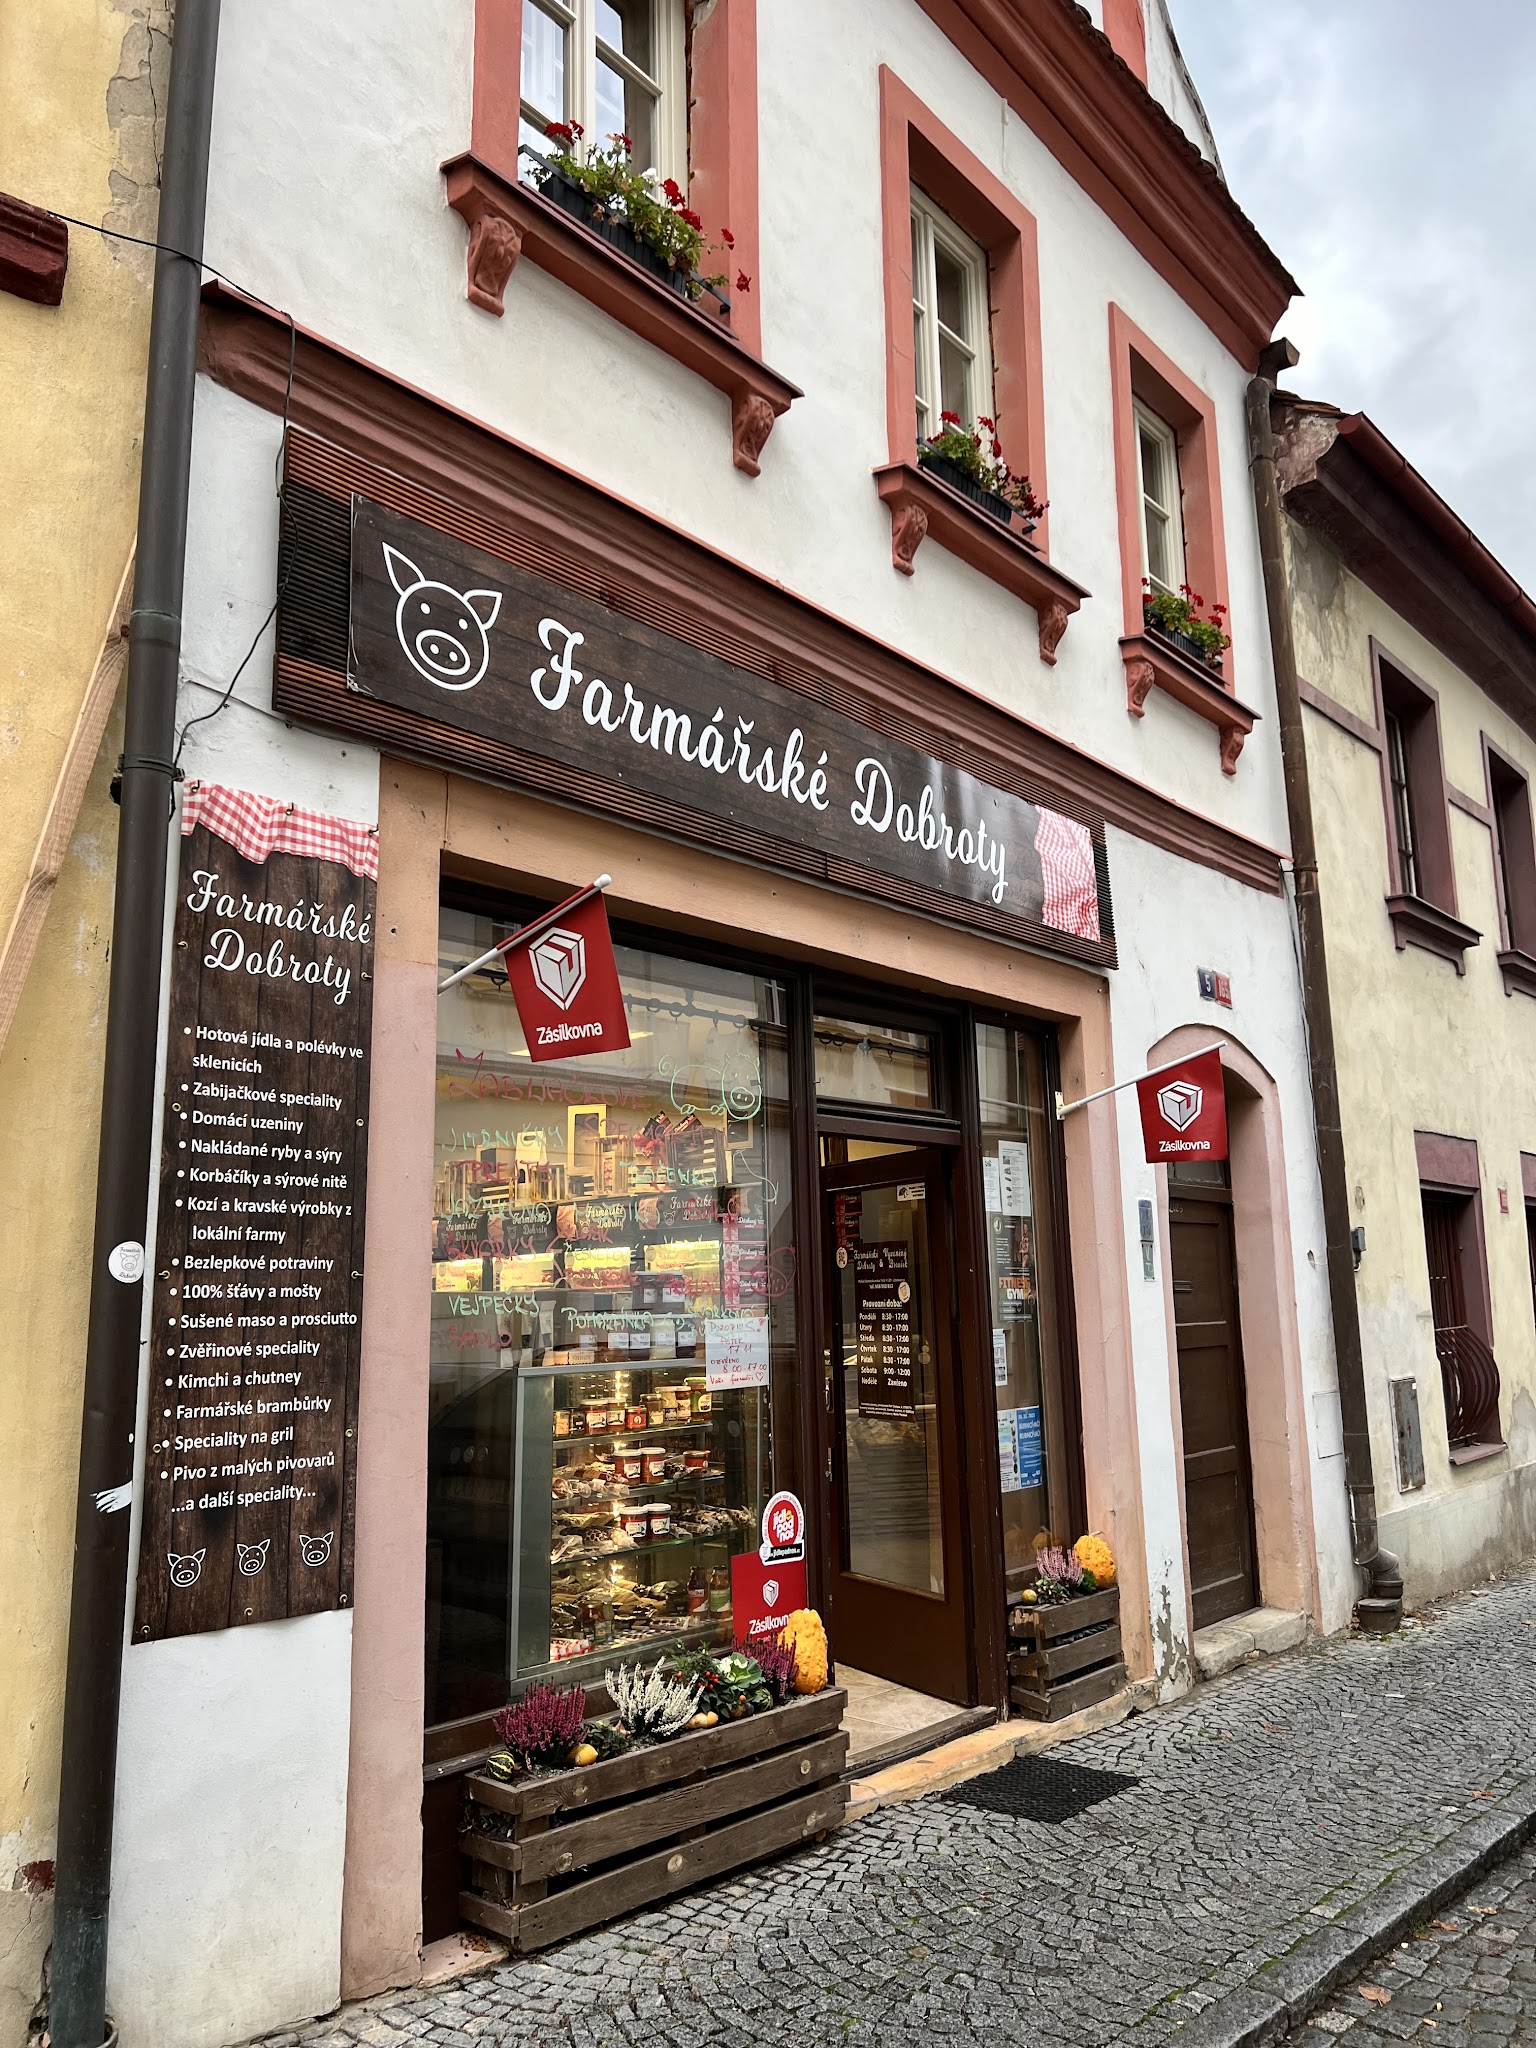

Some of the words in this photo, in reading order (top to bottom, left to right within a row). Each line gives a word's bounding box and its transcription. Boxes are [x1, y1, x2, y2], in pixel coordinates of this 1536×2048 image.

[530, 618, 829, 811] Farmářské
[850, 757, 1009, 904] Dobroty
[186, 869, 373, 944] Farmářské
[203, 928, 353, 1005] Dobroty
[1204, 974, 1212, 993] 5
[196, 1025, 248, 1045] Hotová
[250, 1031, 282, 1049] jídla
[285, 1040, 292, 1049] a
[296, 1039, 347, 1059] polévky
[348, 1047, 364, 1059] ve
[536, 1022, 603, 1045] Zásilkovna
[192, 1053, 262, 1074] sklenicích
[192, 1081, 277, 1103] Zabijačkové
[279, 1092, 343, 1111] speciality
[192, 1110, 248, 1128] Domácí
[250, 1116, 304, 1135] uzeniny
[191, 1138, 268, 1157] Nakládané
[271, 1144, 302, 1162] ryby
[305, 1150, 312, 1159] a
[315, 1147, 343, 1165] sýry
[1158, 1139, 1210, 1152] Zásilkovna
[189, 1167, 260, 1188] Korbáčíky
[263, 1175, 270, 1184] a
[274, 1173, 319, 1189] sýrové
[322, 1174, 348, 1189] nitě
[187, 1196, 219, 1212] Kozí
[222, 1201, 229, 1211] a
[234, 1197, 288, 1214] kravské
[290, 1200, 343, 1219] výrobky
[346, 1206, 351, 1215] z
[192, 1225, 243, 1241] lokální
[245, 1226, 287, 1245] farmy
[184, 1254, 266, 1273] Bezlepkové
[269, 1256, 334, 1273] potraviny
[182, 1284, 223, 1299] 100%
[226, 1282, 266, 1302] šťávy
[269, 1288, 276, 1297] a
[280, 1283, 322, 1301] mošty
[180, 1312, 234, 1329] Sušené
[237, 1315, 276, 1328] maso
[279, 1316, 287, 1326] a
[291, 1311, 358, 1329] prosciutto
[179, 1341, 253, 1359] Zvěřinové
[255, 1339, 321, 1359] speciality
[178, 1371, 229, 1389] Kimchi
[233, 1375, 241, 1385] a
[244, 1370, 302, 1386] chutney
[176, 1399, 253, 1420] Farmářské
[256, 1395, 332, 1414] brambůrky
[174, 1431, 248, 1453] Speciality
[250, 1432, 268, 1444] na
[270, 1425, 294, 1445] gril
[173, 1466, 207, 1481] Pivo
[210, 1467, 217, 1477] z
[221, 1458, 273, 1477] malých
[276, 1450, 335, 1474] pivovarů
[171, 1499, 195, 1513] ...a
[198, 1490, 235, 1510] další
[237, 1484, 316, 1508] speciality...
[776, 1515, 795, 1538] pod
[779, 1528, 795, 1543] nos
[748, 1613, 792, 1635] Zásilkovn
